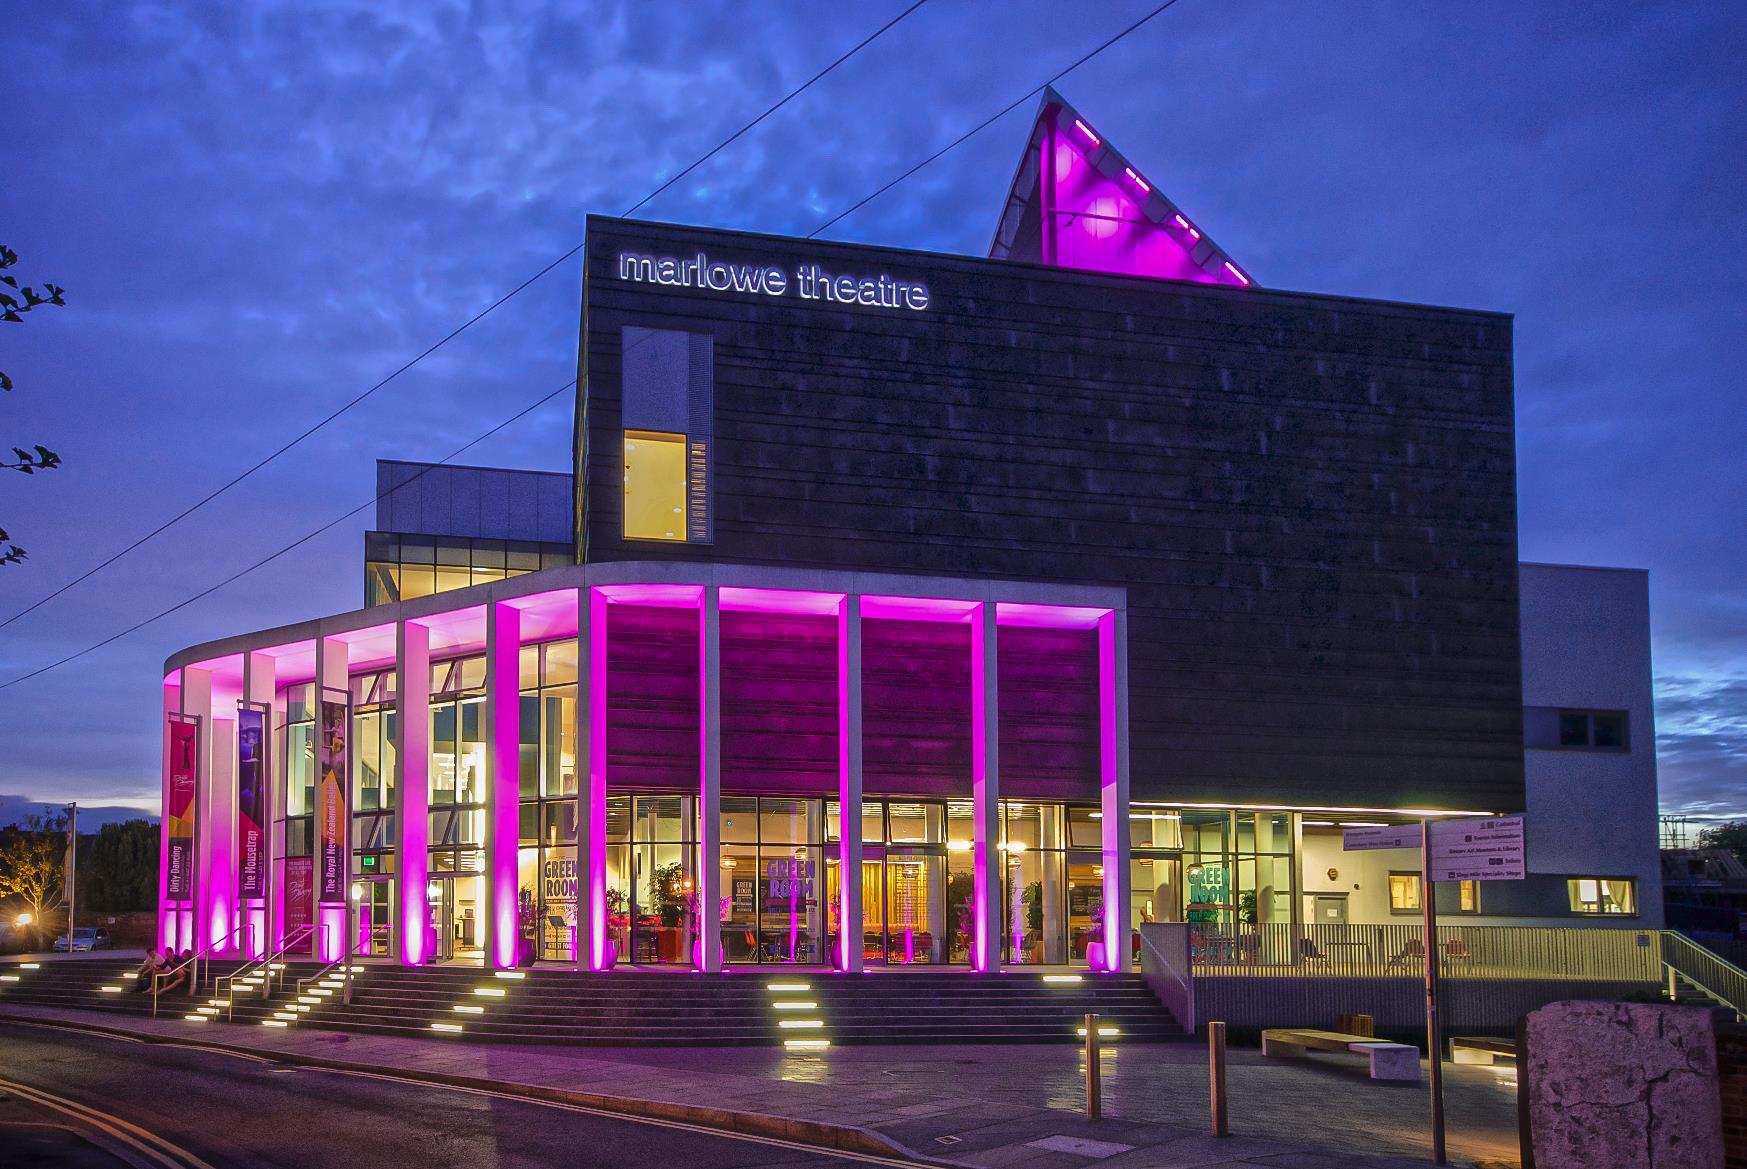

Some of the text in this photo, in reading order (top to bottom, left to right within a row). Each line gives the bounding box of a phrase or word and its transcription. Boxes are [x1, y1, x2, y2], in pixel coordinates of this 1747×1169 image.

[620, 252, 929, 311] marlowe theatre
[327, 806, 337, 836] Zealand
[326, 838, 336, 855] New
[170, 845, 182, 893] Dirty Dancing
[244, 830, 259, 890] The Mousetrap
[326, 857, 337, 877] Royal
[544, 860, 578, 878] GREEN
[767, 859, 816, 879] GREEN
[326, 881, 336, 893] The
[547, 879, 578, 897] ROOM
[770, 879, 814, 898] ROOM
[1191, 885, 1230, 903] ROOM
